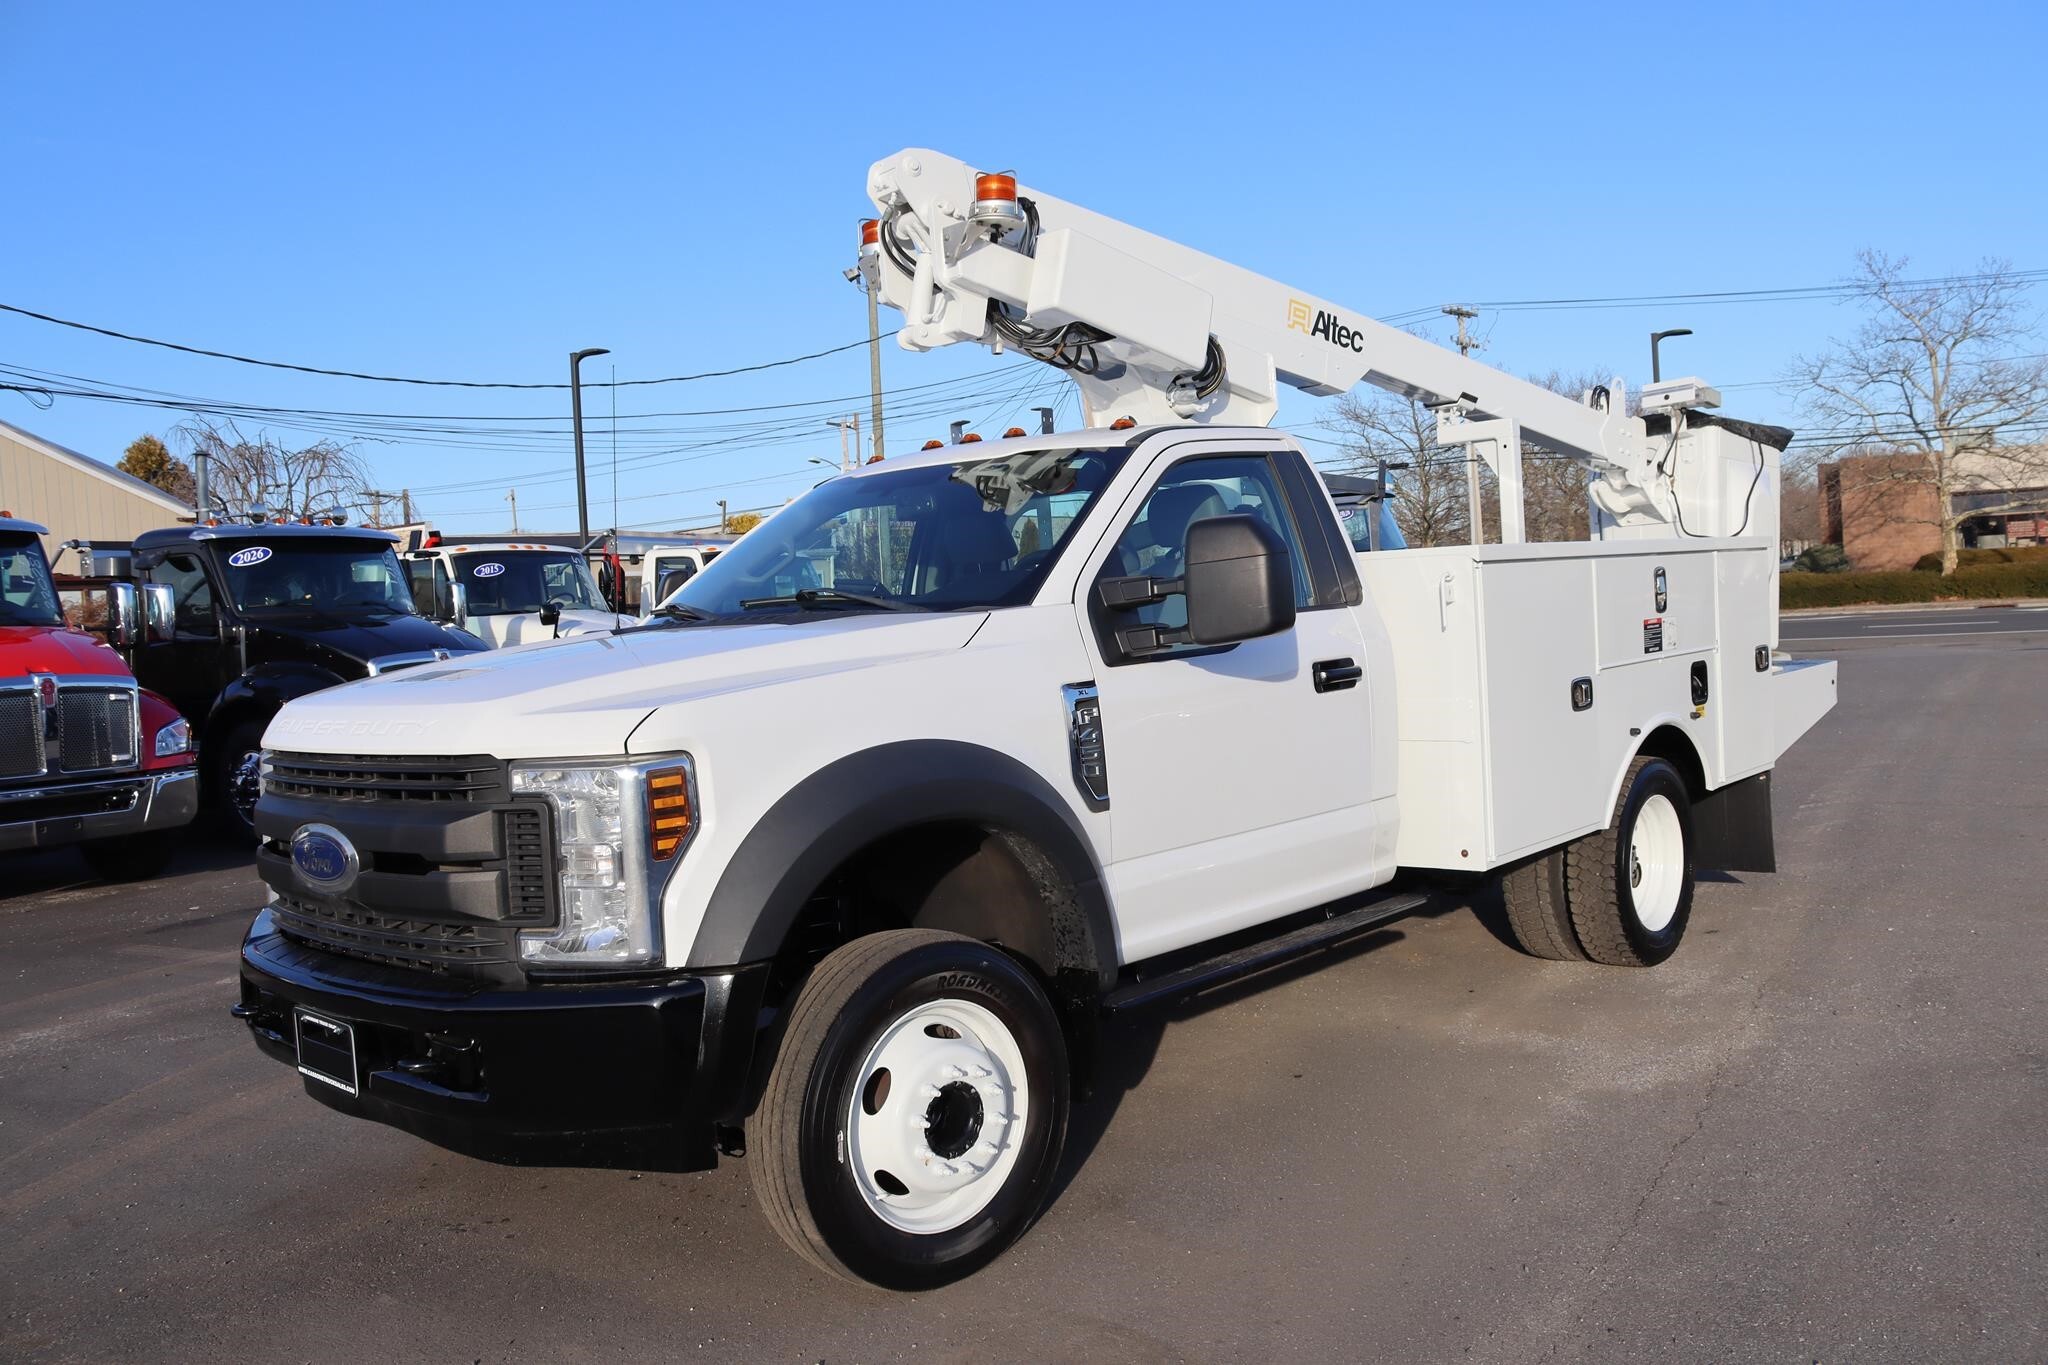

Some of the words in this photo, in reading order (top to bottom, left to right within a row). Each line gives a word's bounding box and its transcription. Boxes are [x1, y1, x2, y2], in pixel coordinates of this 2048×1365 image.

[1311, 310, 1364, 353] Altec
[237, 549, 264, 565] 2026
[480, 564, 499, 576] 2015
[275, 719, 349, 736] SUPER
[351, 719, 438, 736] DUTY
[300, 841, 334, 873] Ford
